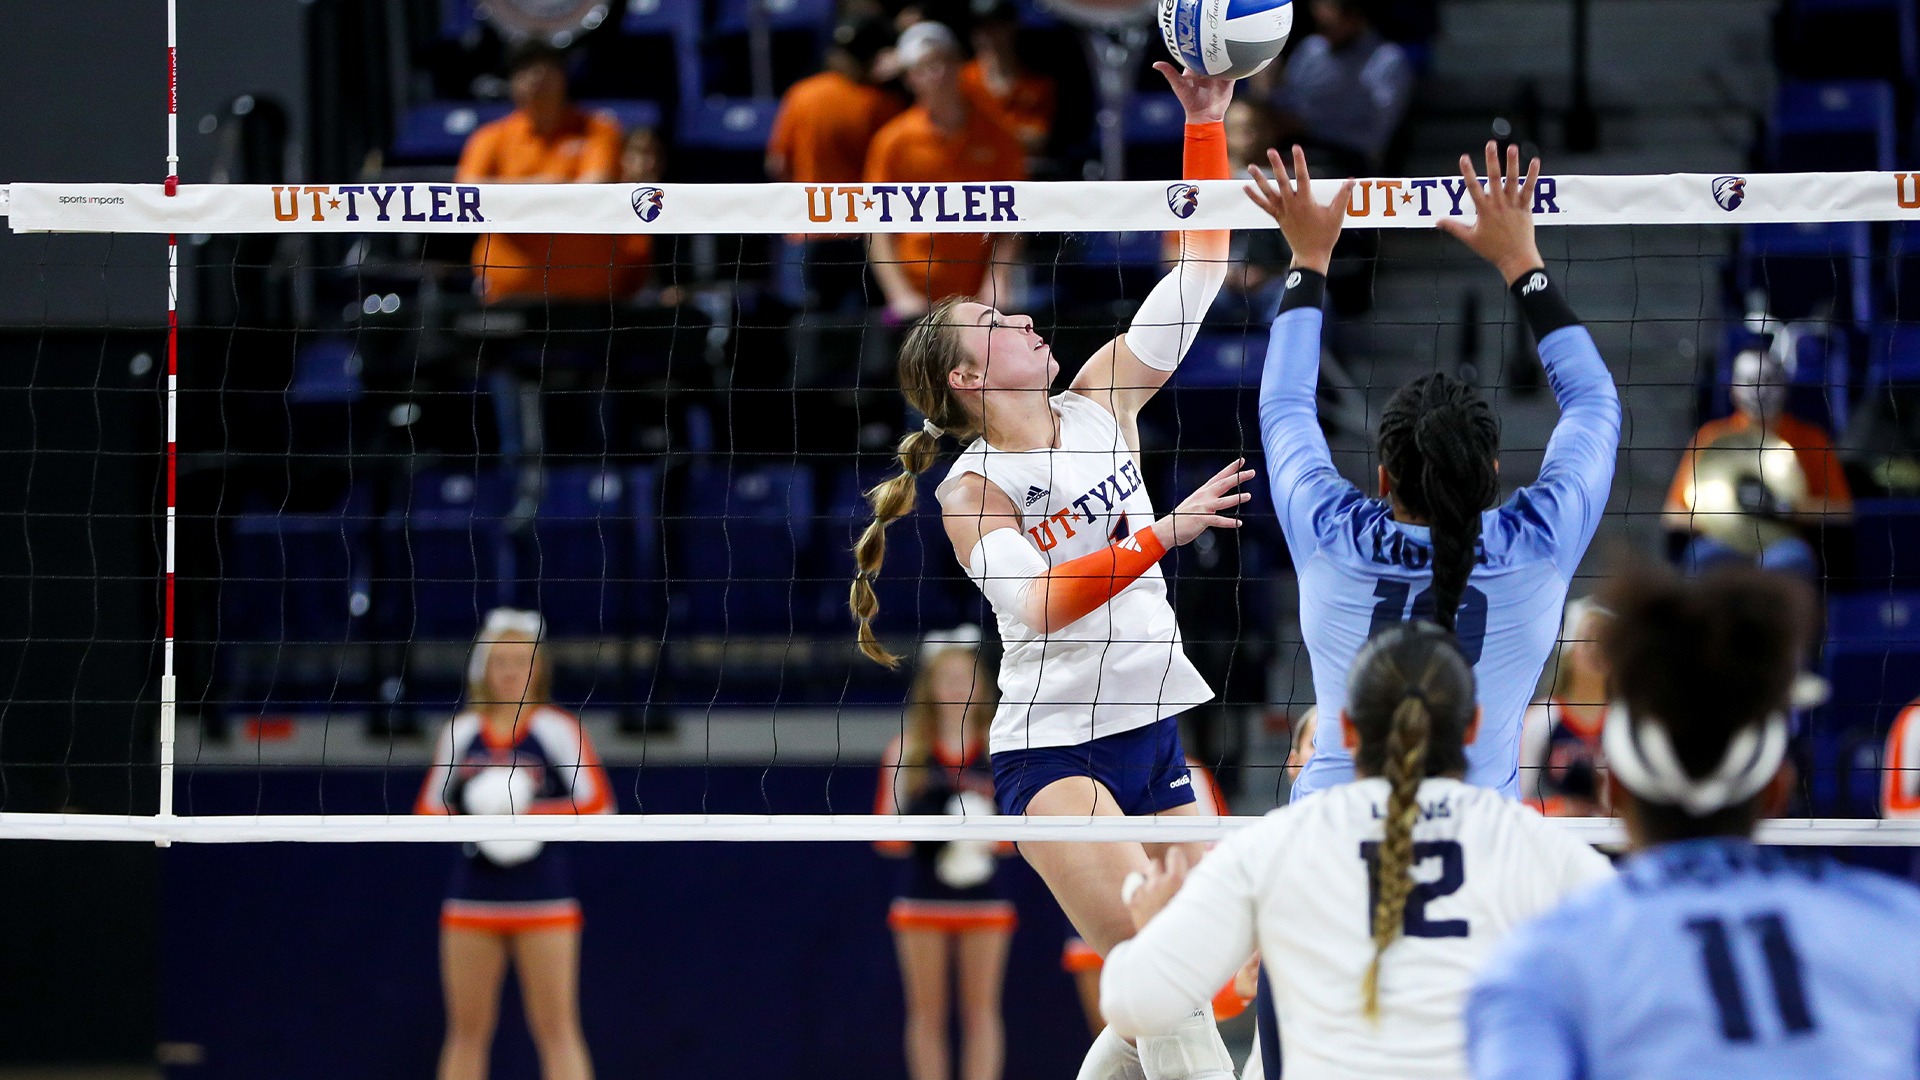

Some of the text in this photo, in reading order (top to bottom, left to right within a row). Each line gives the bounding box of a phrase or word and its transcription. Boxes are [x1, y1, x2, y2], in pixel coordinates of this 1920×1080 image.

[1205, 33, 1222, 62] Super
[59, 195, 125, 206] sports imports
[271, 186, 485, 223] UT TYLER
[804, 185, 1019, 223] UT TYLER
[1411, 177, 1560, 216] TYR
[1025, 490, 1050, 507] adidas
[1360, 840, 1470, 939] 12
[1681, 912, 1820, 1043] 11
